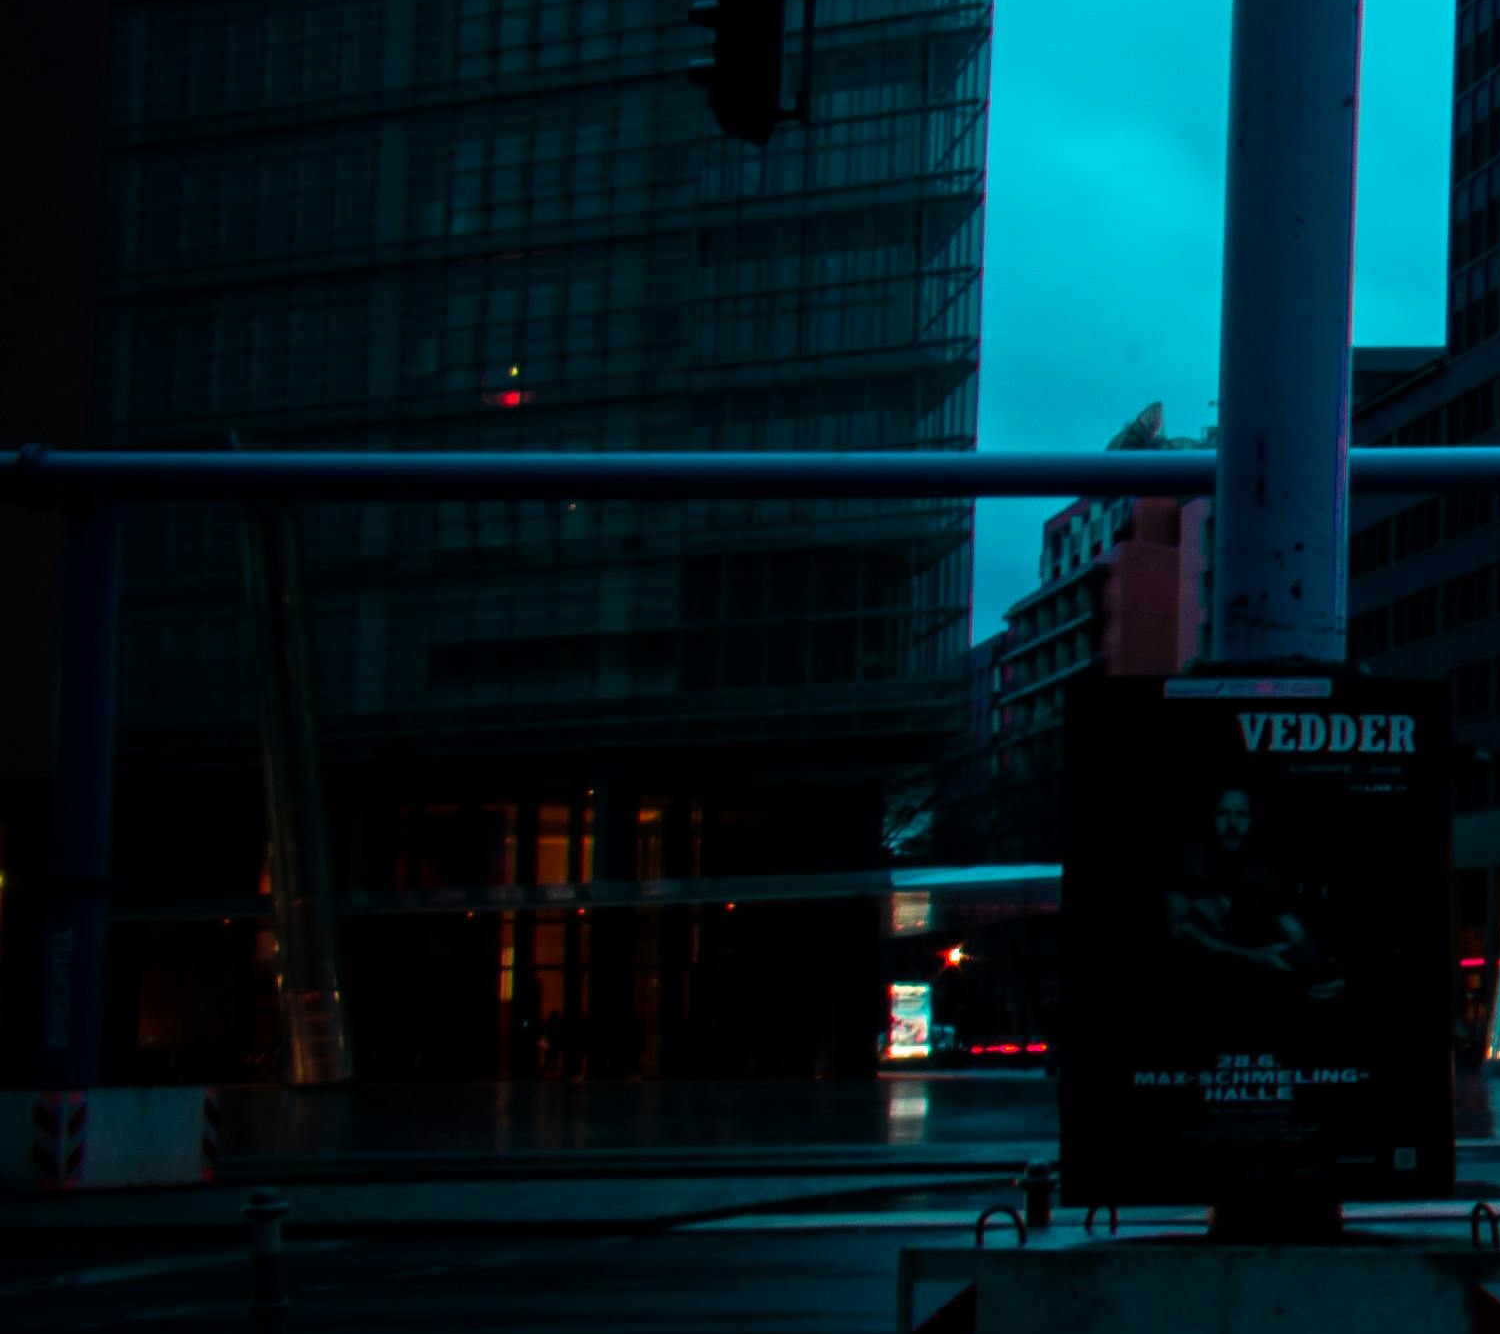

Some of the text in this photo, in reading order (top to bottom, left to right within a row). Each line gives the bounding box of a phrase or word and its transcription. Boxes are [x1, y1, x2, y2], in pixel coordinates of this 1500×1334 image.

[1236, 711, 1417, 754] VEDDER
[1133, 1068, 1371, 1086] MAX-SCHMELING-
[1203, 1085, 1295, 1102] HALLE
